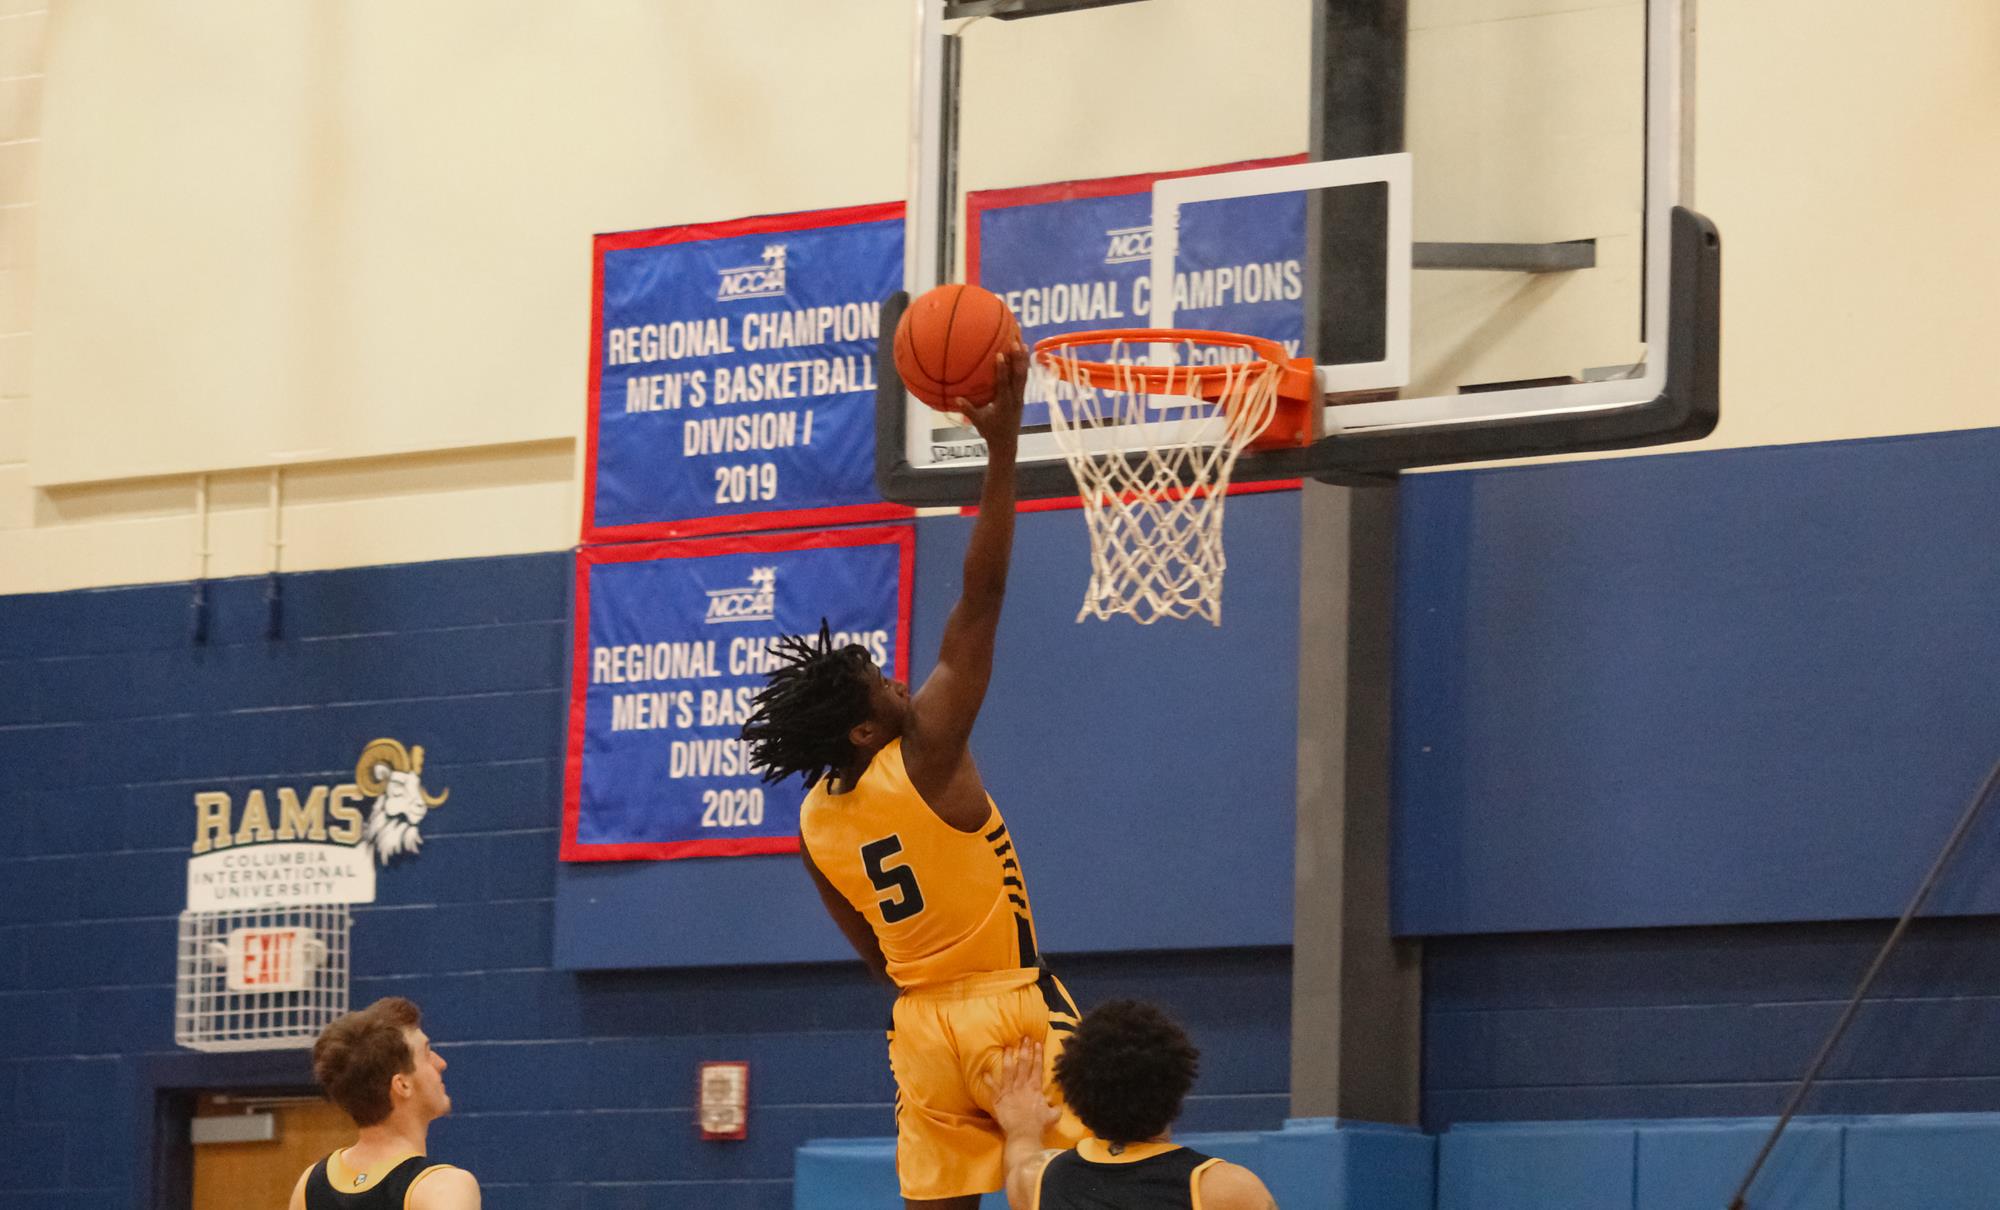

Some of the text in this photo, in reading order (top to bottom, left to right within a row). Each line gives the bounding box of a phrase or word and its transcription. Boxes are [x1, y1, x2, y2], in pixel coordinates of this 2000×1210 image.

[717, 269, 785, 296] NCCAA
[994, 259, 1302, 328] EGIONAL CAMPIONS
[608, 301, 880, 365] REGIONAL CHAMPION
[626, 355, 878, 413] MEN'S BASKETBALL
[683, 410, 813, 457] DIVISION I
[931, 443, 988, 464] SPALDIN
[715, 463, 777, 504] 2019
[706, 592, 775, 618] NCCAA
[593, 641, 722, 684] REGIONAL
[611, 690, 694, 732] MEN'S
[193, 784, 364, 853] RAMS
[702, 788, 764, 828] 2020
[194, 866, 357, 884] INTERNATIONAL
[223, 851, 327, 868] COLUMBIA
[860, 832, 925, 925] 5
[214, 882, 335, 900] UNIVERSITY
[243, 931, 297, 985] EXIT
